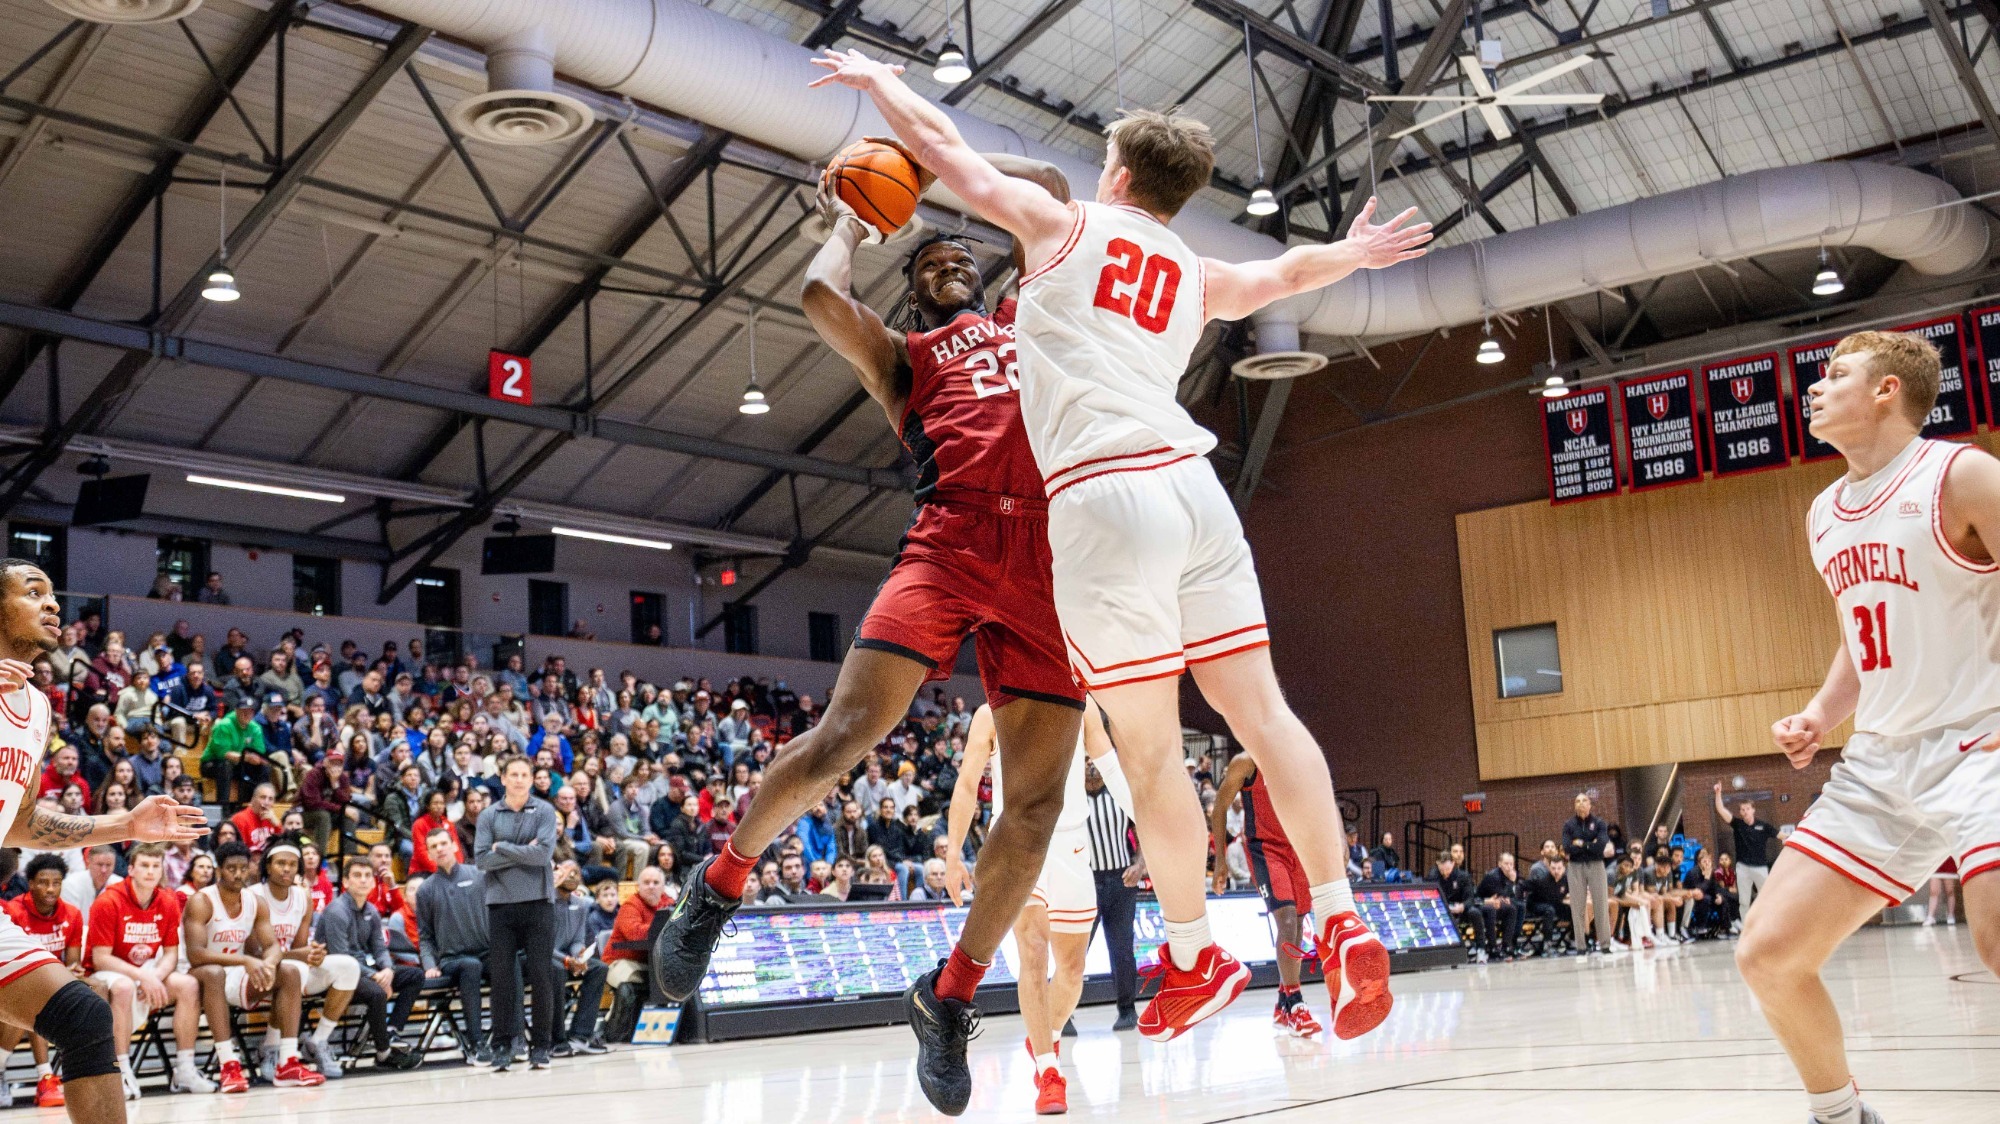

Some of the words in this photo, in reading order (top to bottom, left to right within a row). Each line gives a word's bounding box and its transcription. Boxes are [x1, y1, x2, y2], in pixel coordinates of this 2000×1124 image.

[1093, 237, 1182, 334] 20
[1795, 346, 1836, 364] HARV
[502, 359, 523, 397] 2
[964, 342, 1020, 399] 22
[1709, 359, 1773, 381] HARVARD
[1626, 376, 1687, 398] HARVARD
[1736, 379, 1749, 398] H
[1546, 392, 1605, 413] HARVARD
[1652, 396, 1664, 414] H
[1714, 409, 1734, 423] IVY
[1735, 401, 1777, 420] LEAGUE
[1571, 412, 1583, 429] H
[1631, 423, 1649, 438] IVY
[1651, 416, 1691, 435] LEAGUE
[1714, 413, 1779, 435] CHAMPIONS
[1564, 435, 1597, 452] NCAA
[1632, 428, 1692, 449] TOURNAMENT
[1727, 437, 1771, 460] 1986
[1552, 444, 1610, 463] TOURNAMENT
[1633, 440, 1694, 461] CHAMPIONS
[1584, 455, 1611, 470] 1997
[1644, 458, 1685, 480] 1986
[1587, 479, 1614, 493] 2007
[1853, 602, 1892, 672] 31
